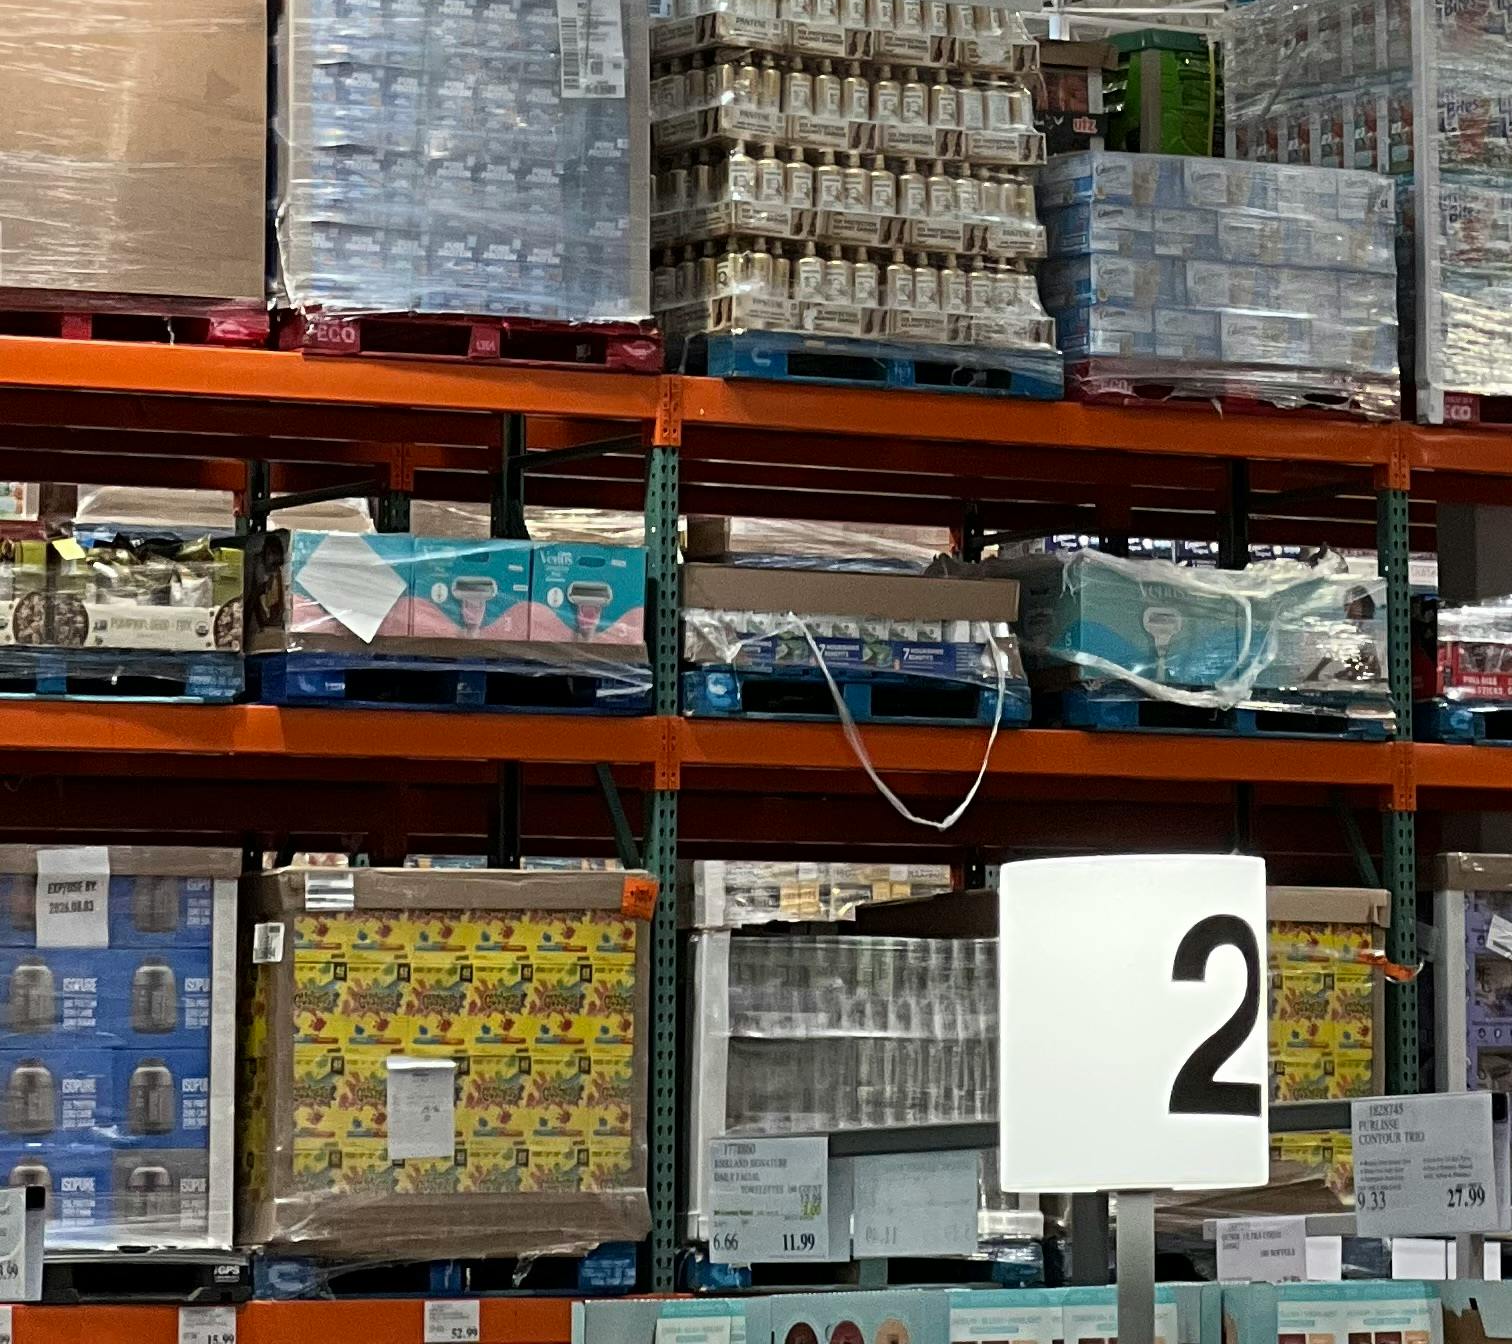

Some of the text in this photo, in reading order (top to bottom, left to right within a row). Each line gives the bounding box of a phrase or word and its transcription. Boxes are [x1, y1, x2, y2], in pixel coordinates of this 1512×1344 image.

[1074, 118, 1098, 134] utz
[1168, 913, 1262, 1117] 2
[1358, 1132, 1401, 1145] CONTOUR
[1358, 1186, 1486, 1210] 9.33 27.99
[713, 1232, 815, 1251] 6.66 11.99
[451, 1326, 479, 1342] 52.99
